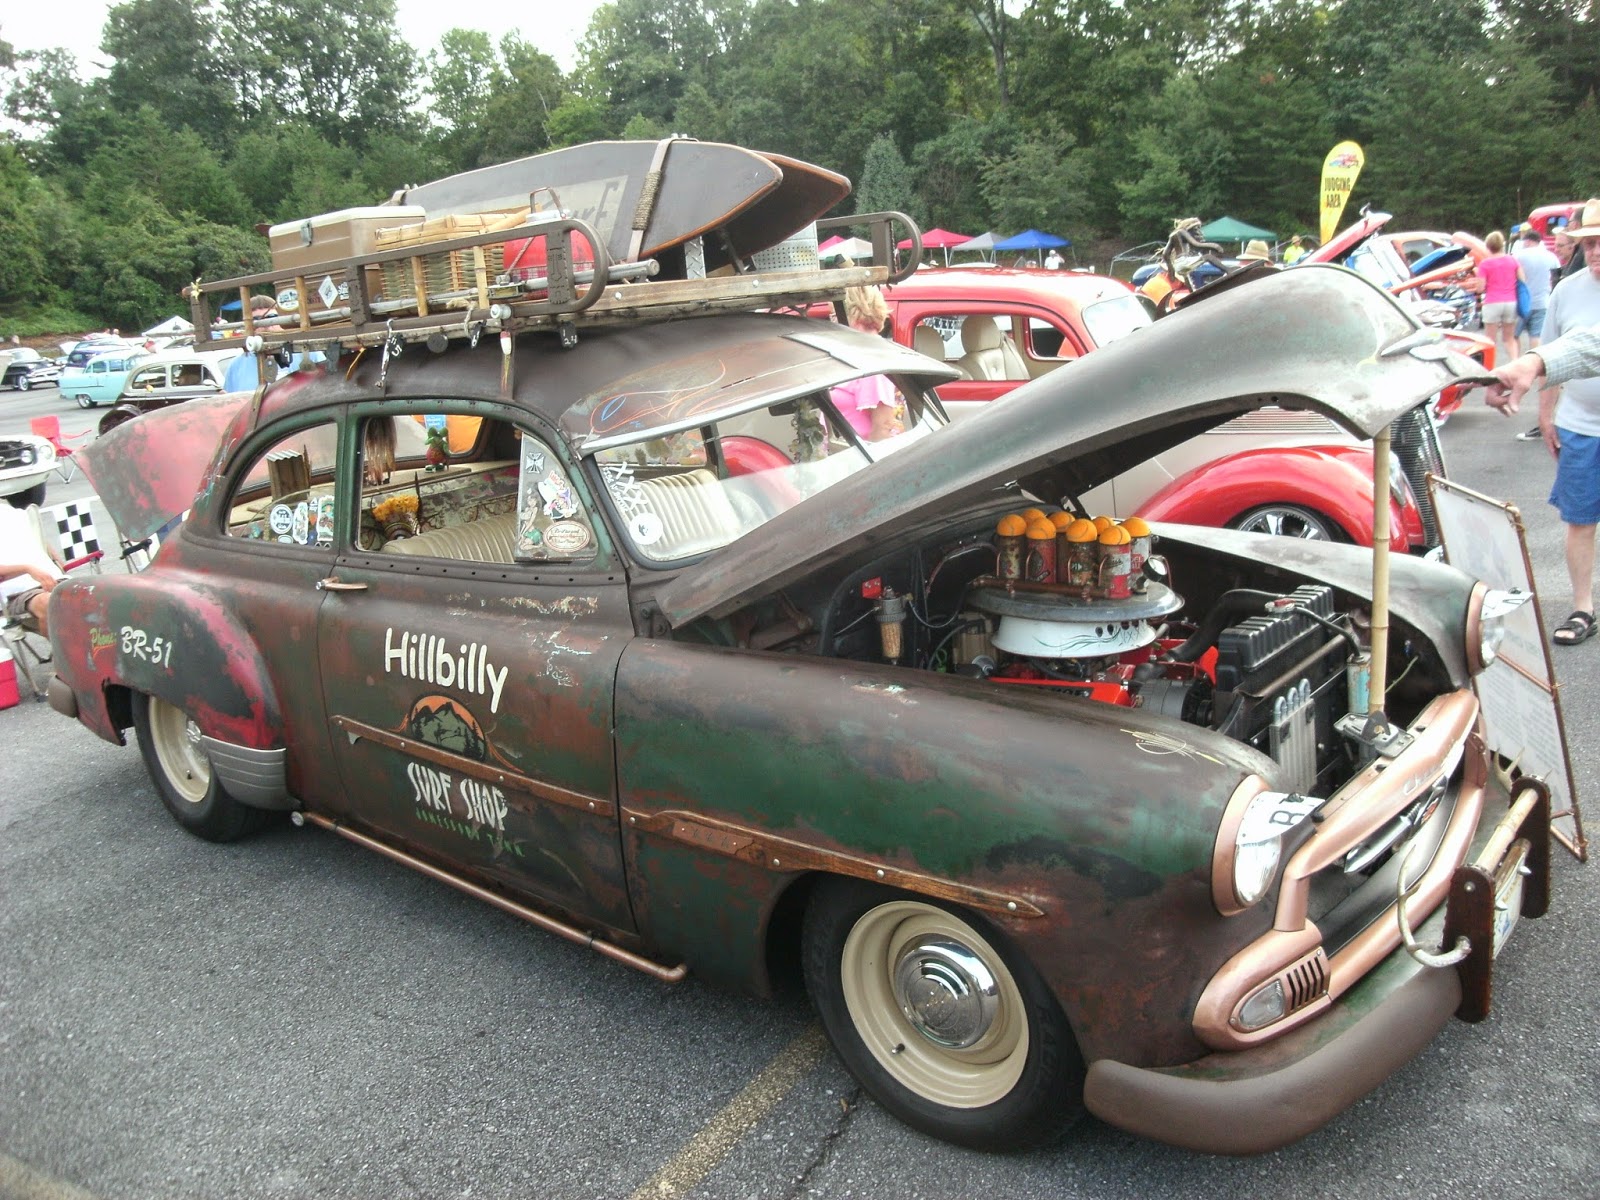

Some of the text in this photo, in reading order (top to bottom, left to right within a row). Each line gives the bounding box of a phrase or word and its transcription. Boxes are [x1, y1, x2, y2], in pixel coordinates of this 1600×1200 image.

[1324, 177, 1351, 191] JUDGING
[1326, 194, 1341, 208] AREA
[120, 625, 172, 669] BR-51
[384, 627, 509, 714] Hillbilly
[406, 762, 508, 831] SURF SHOP
